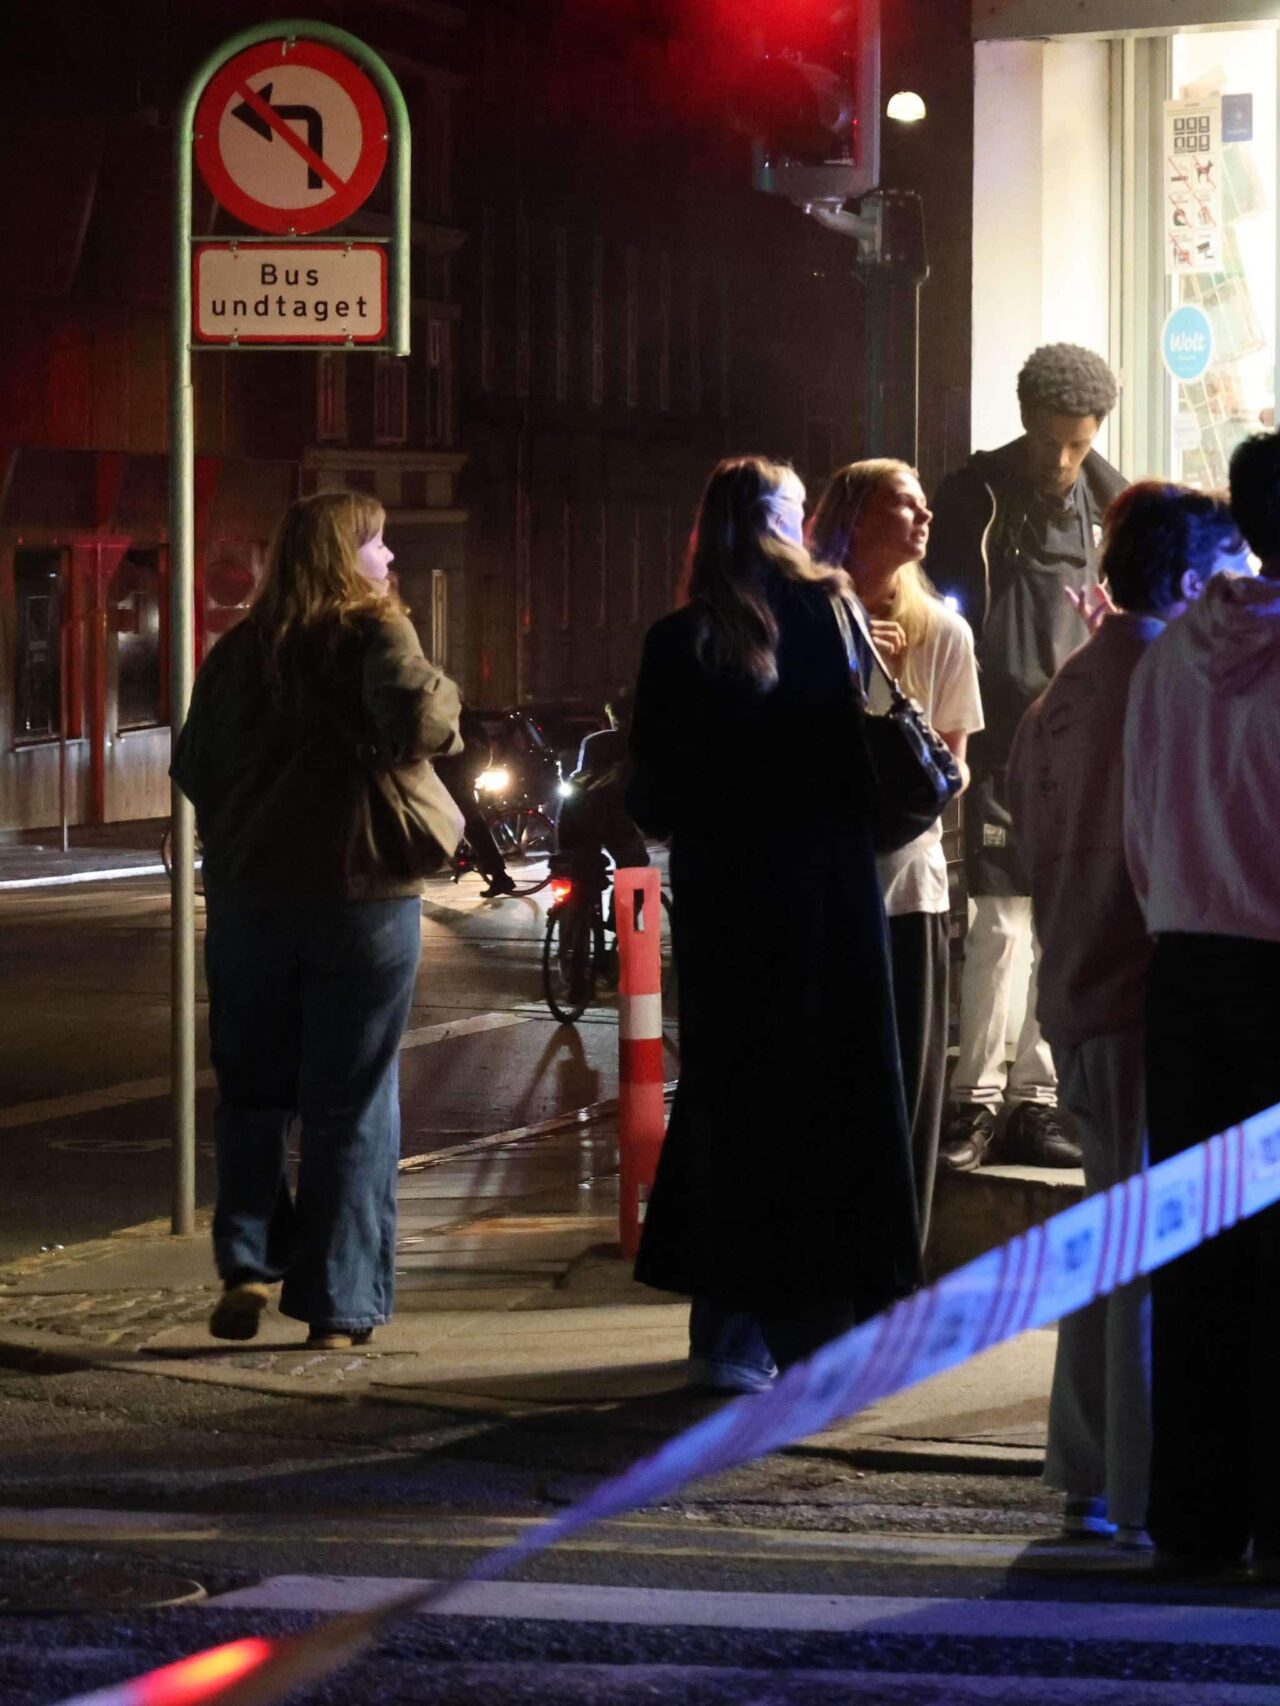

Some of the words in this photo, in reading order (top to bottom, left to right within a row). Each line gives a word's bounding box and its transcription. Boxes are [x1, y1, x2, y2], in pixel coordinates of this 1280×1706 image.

[260, 263, 320, 286] Bus
[211, 295, 368, 322] undtaget
[1170, 330, 1206, 353] Wolt
